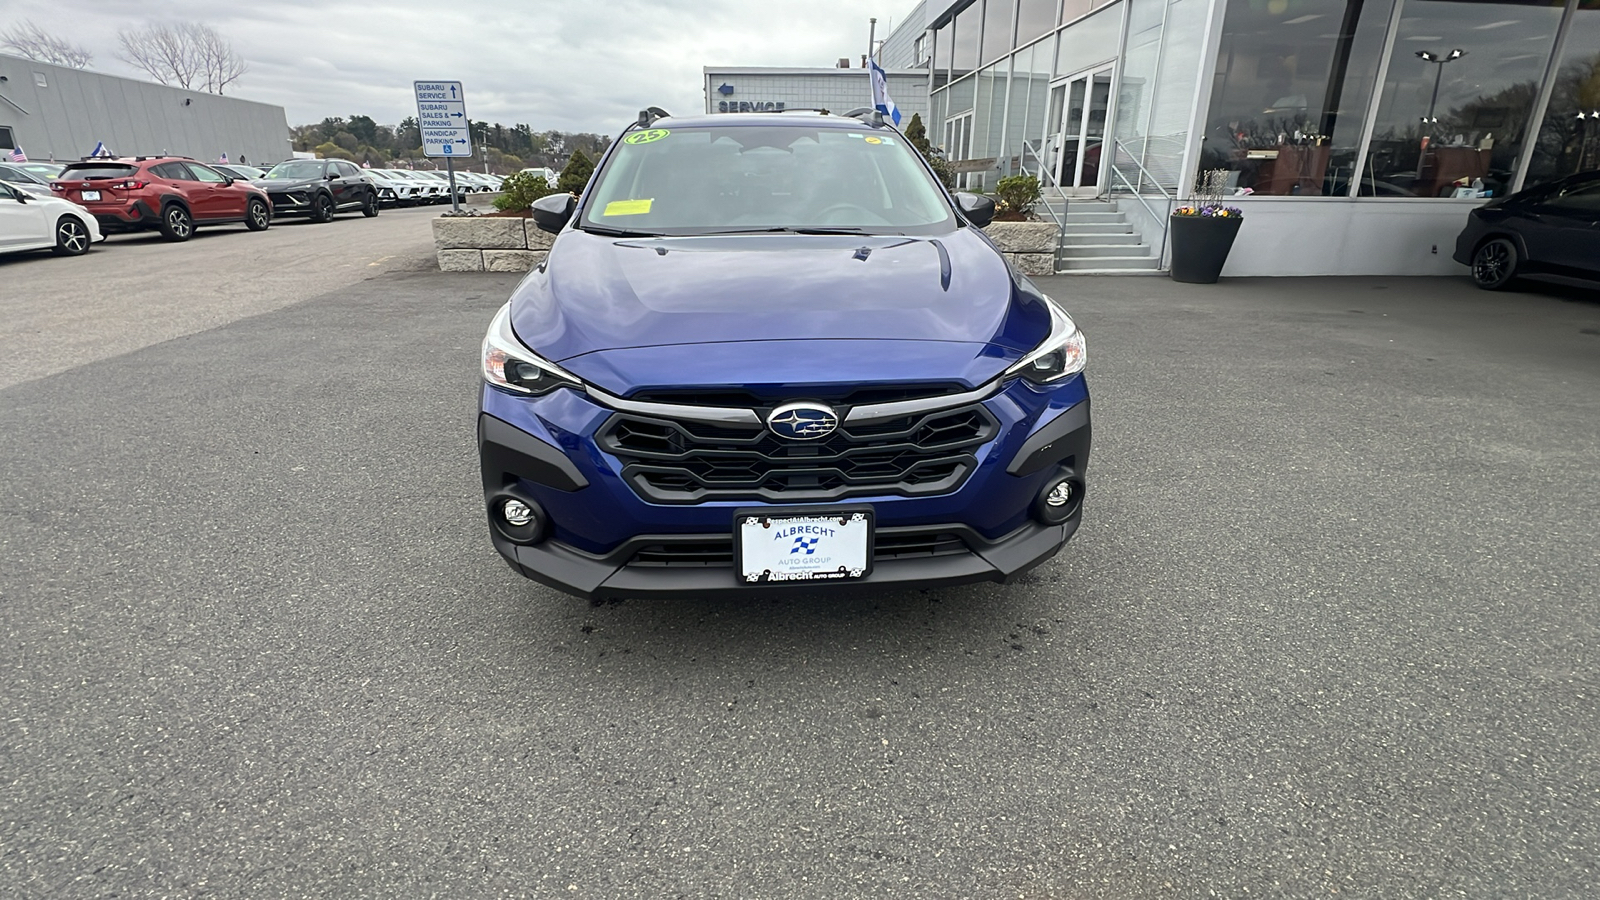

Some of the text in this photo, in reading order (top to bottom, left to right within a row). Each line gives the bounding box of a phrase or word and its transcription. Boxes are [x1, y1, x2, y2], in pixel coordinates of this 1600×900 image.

[719, 101, 785, 113] SERVICE
[633, 130, 660, 143] 25
[774, 525, 835, 540] ALBRECHT
[778, 556, 832, 566] AUTO GROUP
[768, 570, 813, 581] Albrecht
